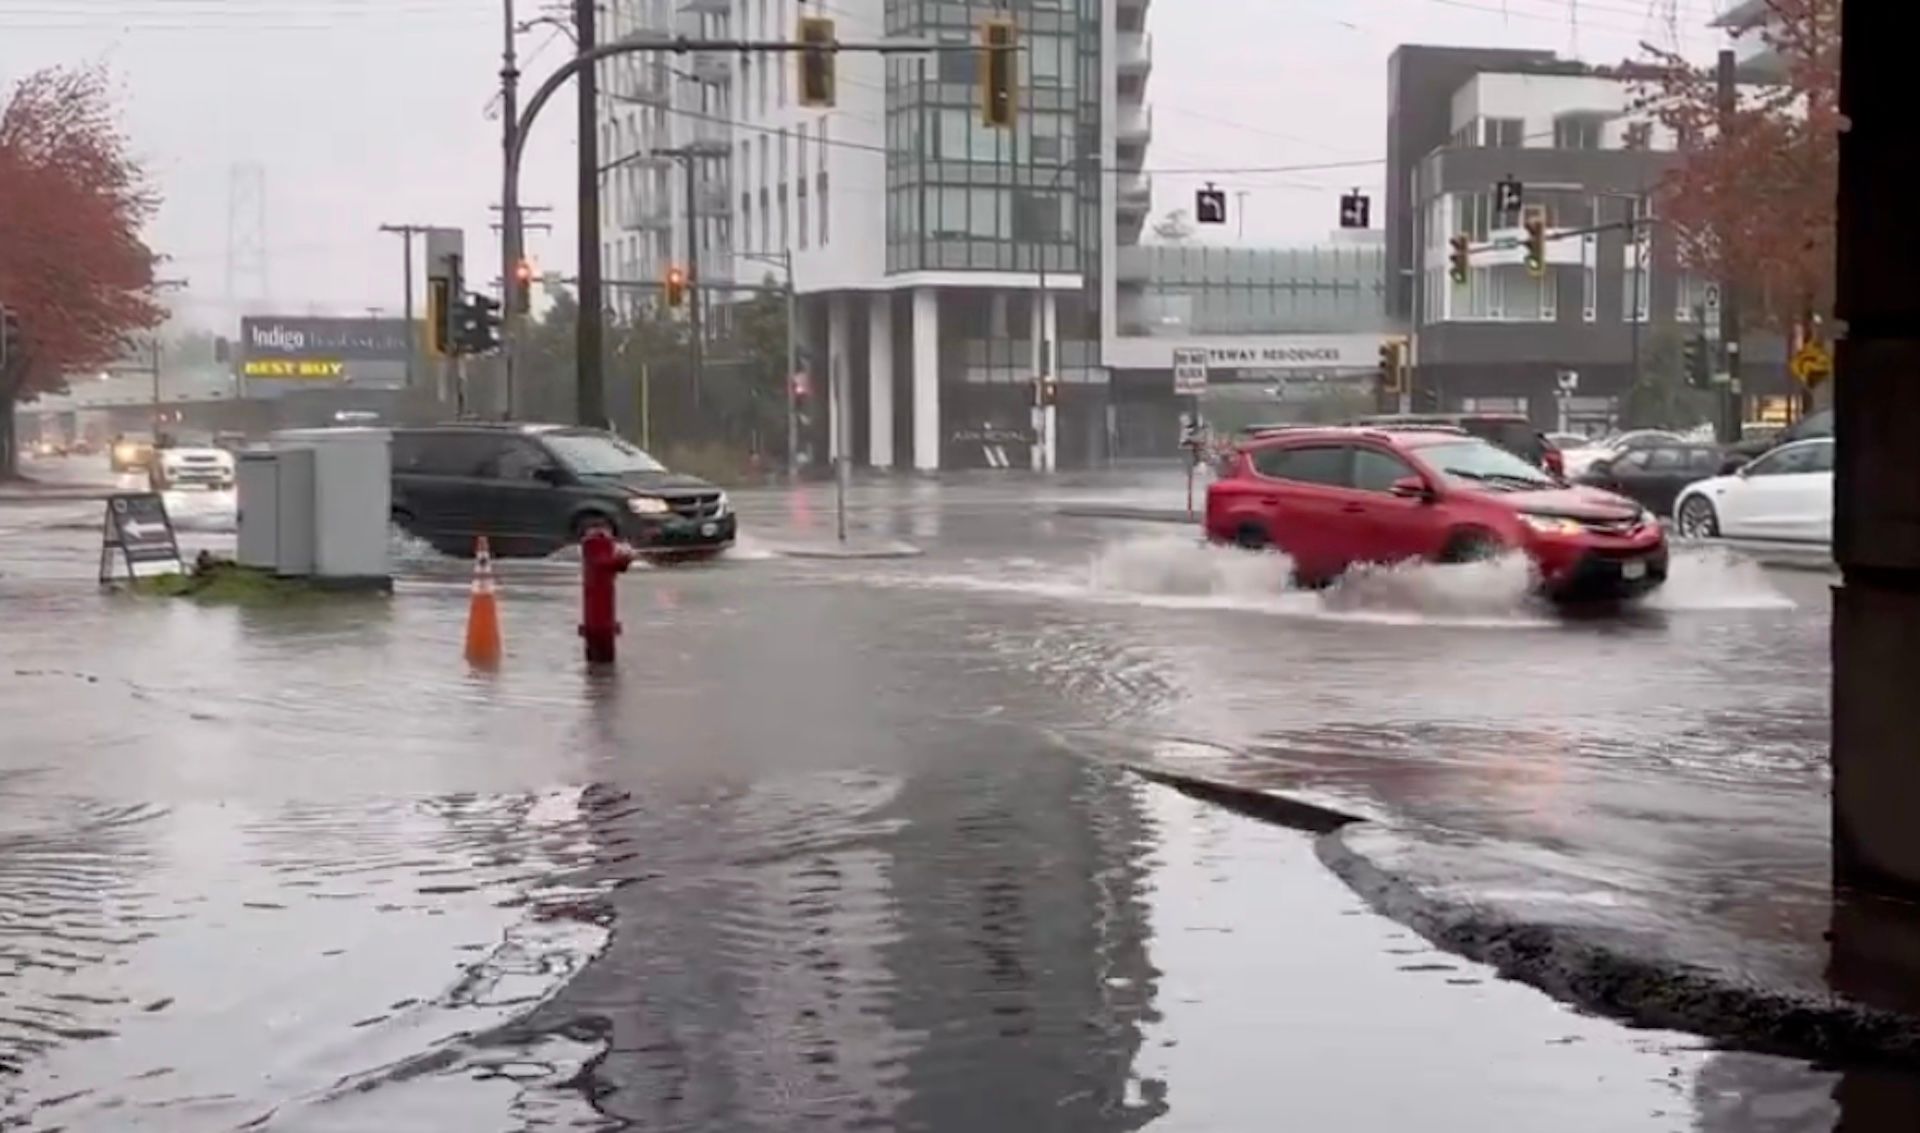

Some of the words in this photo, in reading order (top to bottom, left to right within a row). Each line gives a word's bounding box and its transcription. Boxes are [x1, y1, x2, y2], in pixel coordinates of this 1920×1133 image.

[252, 324, 305, 350] Indigo
[1210, 349, 1256, 361] TEWAY
[1263, 349, 1340, 361] RESIDENCES
[244, 361, 296, 375] BEST
[299, 361, 343, 375] BUY
